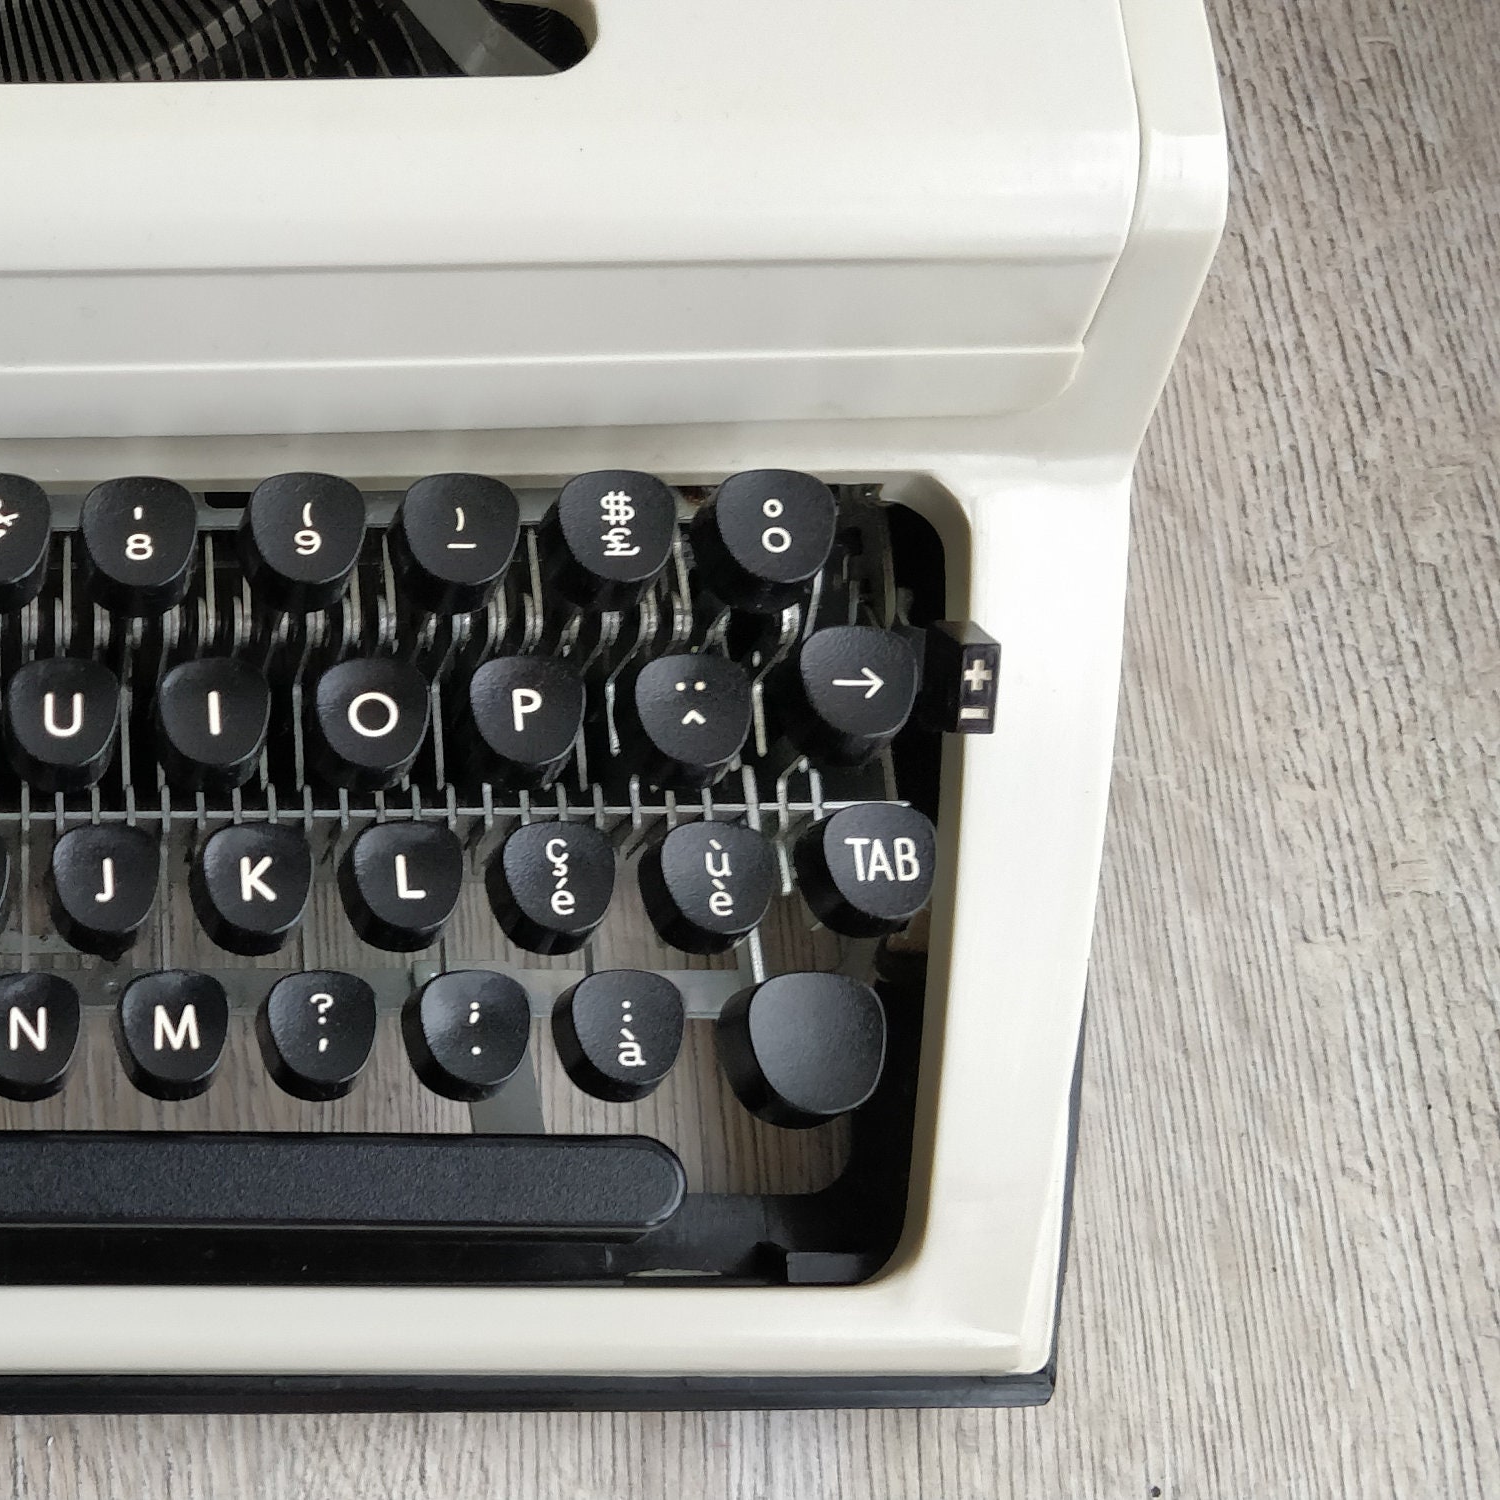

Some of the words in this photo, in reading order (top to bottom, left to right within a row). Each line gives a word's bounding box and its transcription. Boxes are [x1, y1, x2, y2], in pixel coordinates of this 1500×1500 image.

[599, 490, 637, 525] $
[125, 533, 154, 561] 8
[294, 529, 323, 556] 9
[44, 692, 83, 738] U
[207, 690, 221, 736] I
[347, 692, 399, 738] O
[511, 688, 543, 732] P
[240, 856, 277, 902] K
[395, 854, 427, 900] L
[545, 838, 569, 877] ç
[705, 840, 732, 877] ù
[845, 837, 921, 883] TAB
[95, 857, 114, 903] J
[550, 878, 575, 916] é
[708, 878, 734, 917] è
[9, 1006, 47, 1051] N
[153, 1004, 200, 1050] M
[617, 1027, 647, 1067] à
